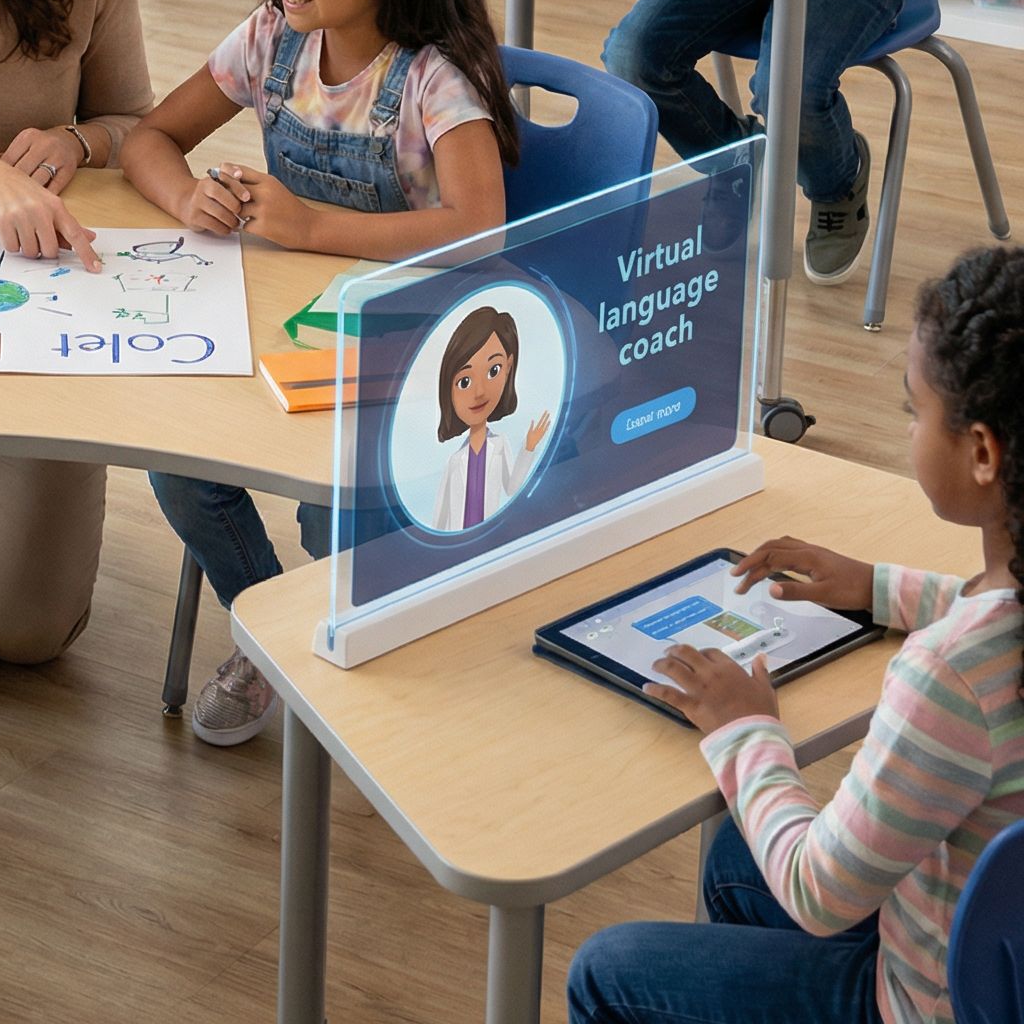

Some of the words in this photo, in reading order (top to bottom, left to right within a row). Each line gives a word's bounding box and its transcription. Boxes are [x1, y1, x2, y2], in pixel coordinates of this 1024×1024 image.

[616, 224, 703, 284] Virtual
[598, 268, 720, 335] language
[618, 313, 693, 366] coach
